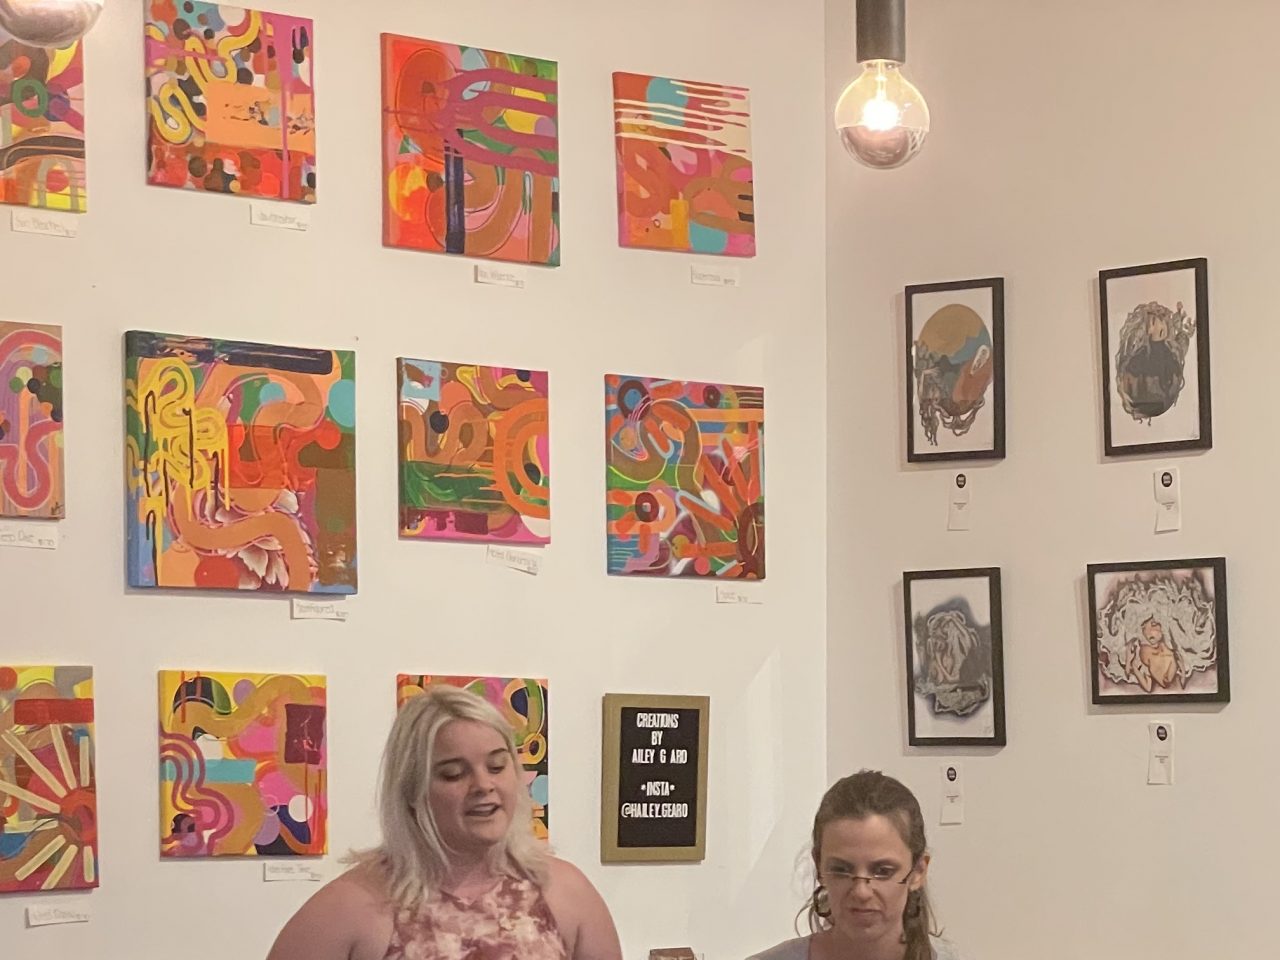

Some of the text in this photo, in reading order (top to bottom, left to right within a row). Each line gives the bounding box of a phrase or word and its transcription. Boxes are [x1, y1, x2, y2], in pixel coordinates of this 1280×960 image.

[636, 712, 679, 729] CREATIONS
[651, 730, 664, 746] BY
[631, 748, 655, 764] AILEY
[670, 748, 688, 764] ARO
